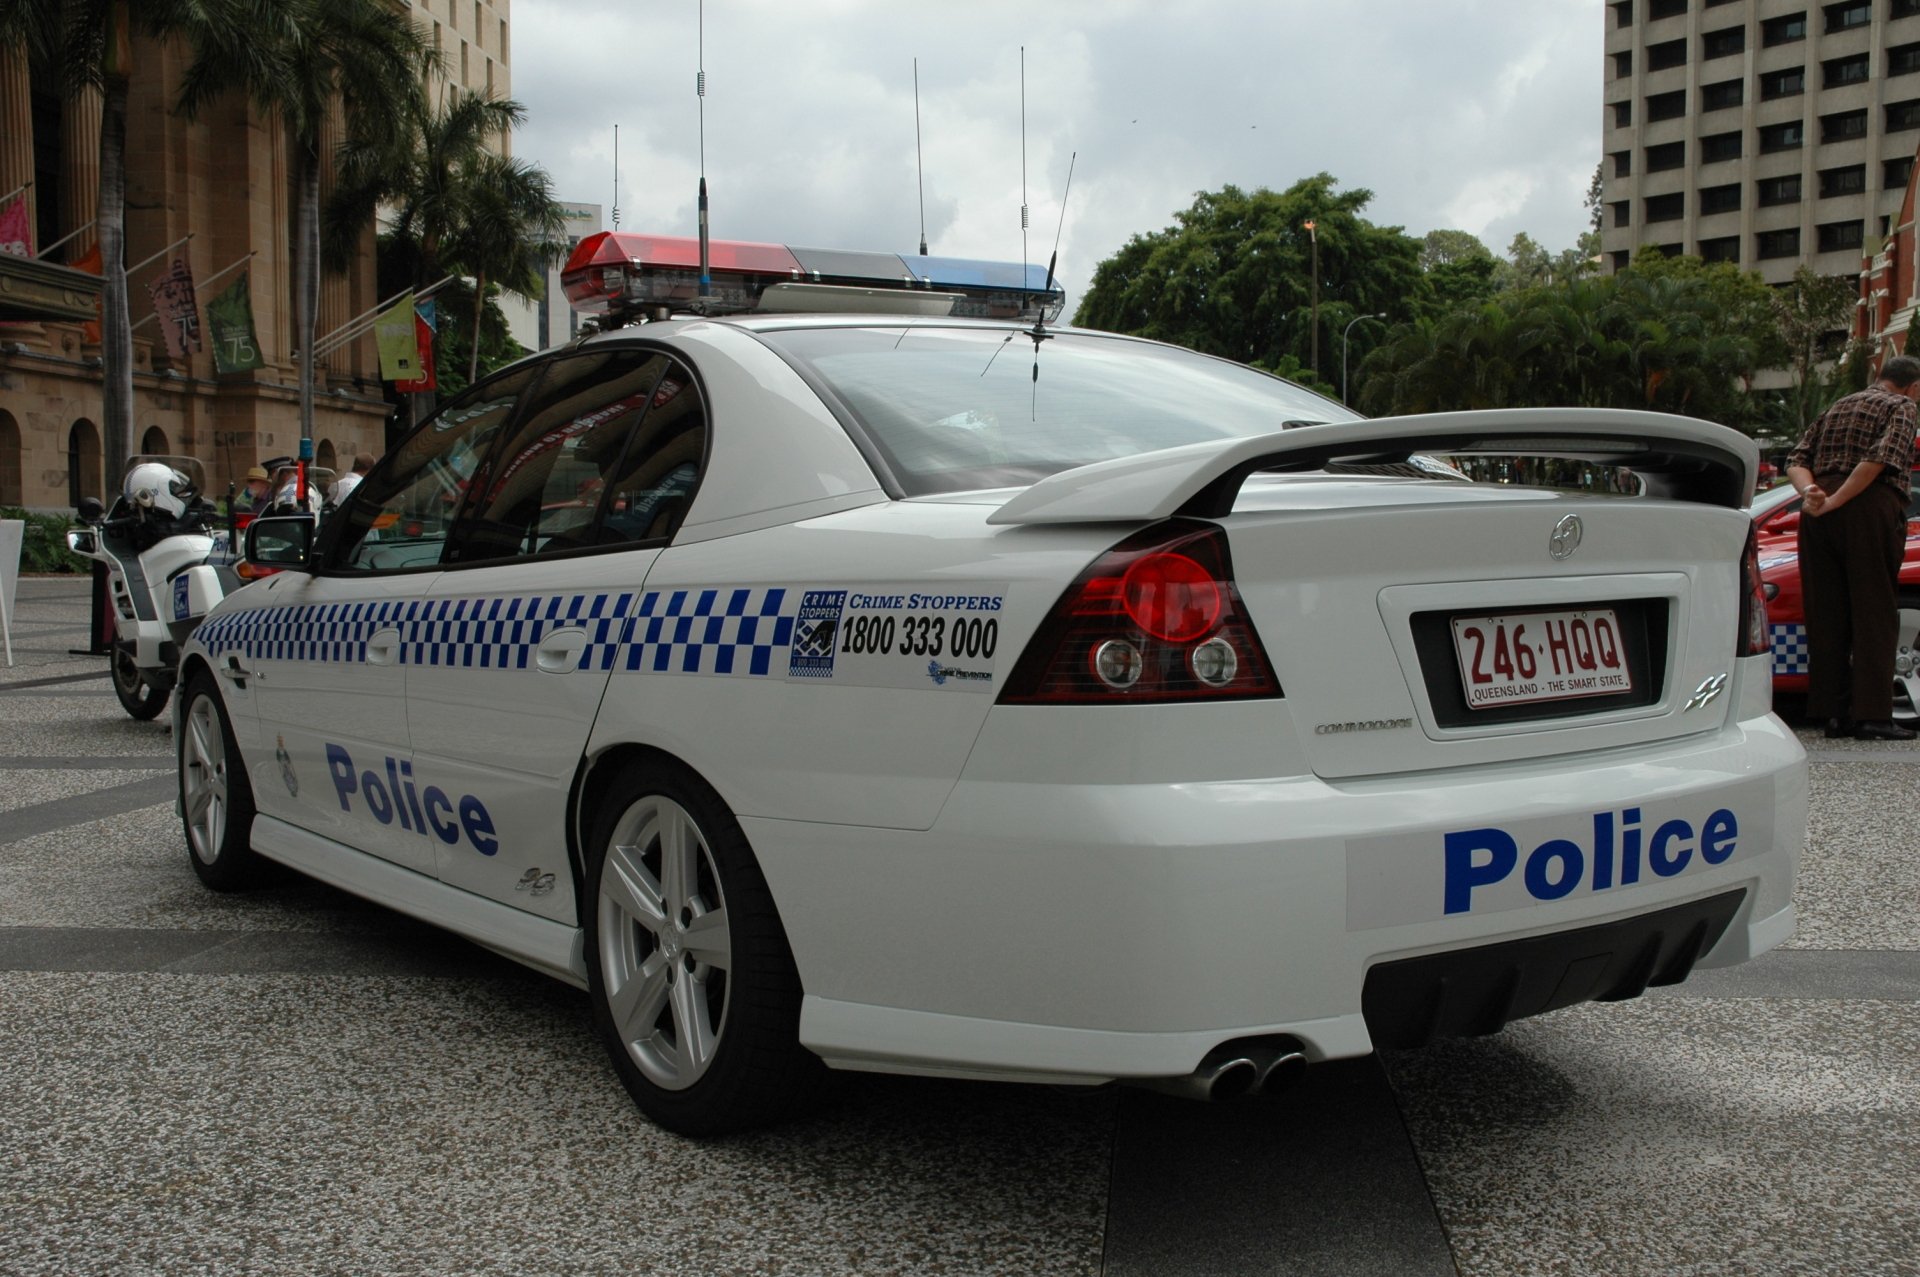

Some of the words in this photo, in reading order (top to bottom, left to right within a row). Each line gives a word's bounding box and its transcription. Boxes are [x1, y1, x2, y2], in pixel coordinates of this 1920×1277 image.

[224, 336, 255, 364] 75
[800, 608, 840, 618] STOPPERS
[803, 594, 844, 606] CRIME
[850, 594, 905, 609] CRIME
[907, 593, 1002, 611] STOPPERS
[842, 616, 895, 655] 1800
[900, 616, 945, 656] 333
[951, 617, 998, 659] 000
[1474, 683, 1538, 701] QUEENSLAND
[1548, 681, 1565, 693] THE
[1568, 677, 1597, 690] SMART
[1600, 674, 1624, 687] STATE
[325, 742, 499, 857] Police
[1443, 807, 1738, 916] Police
